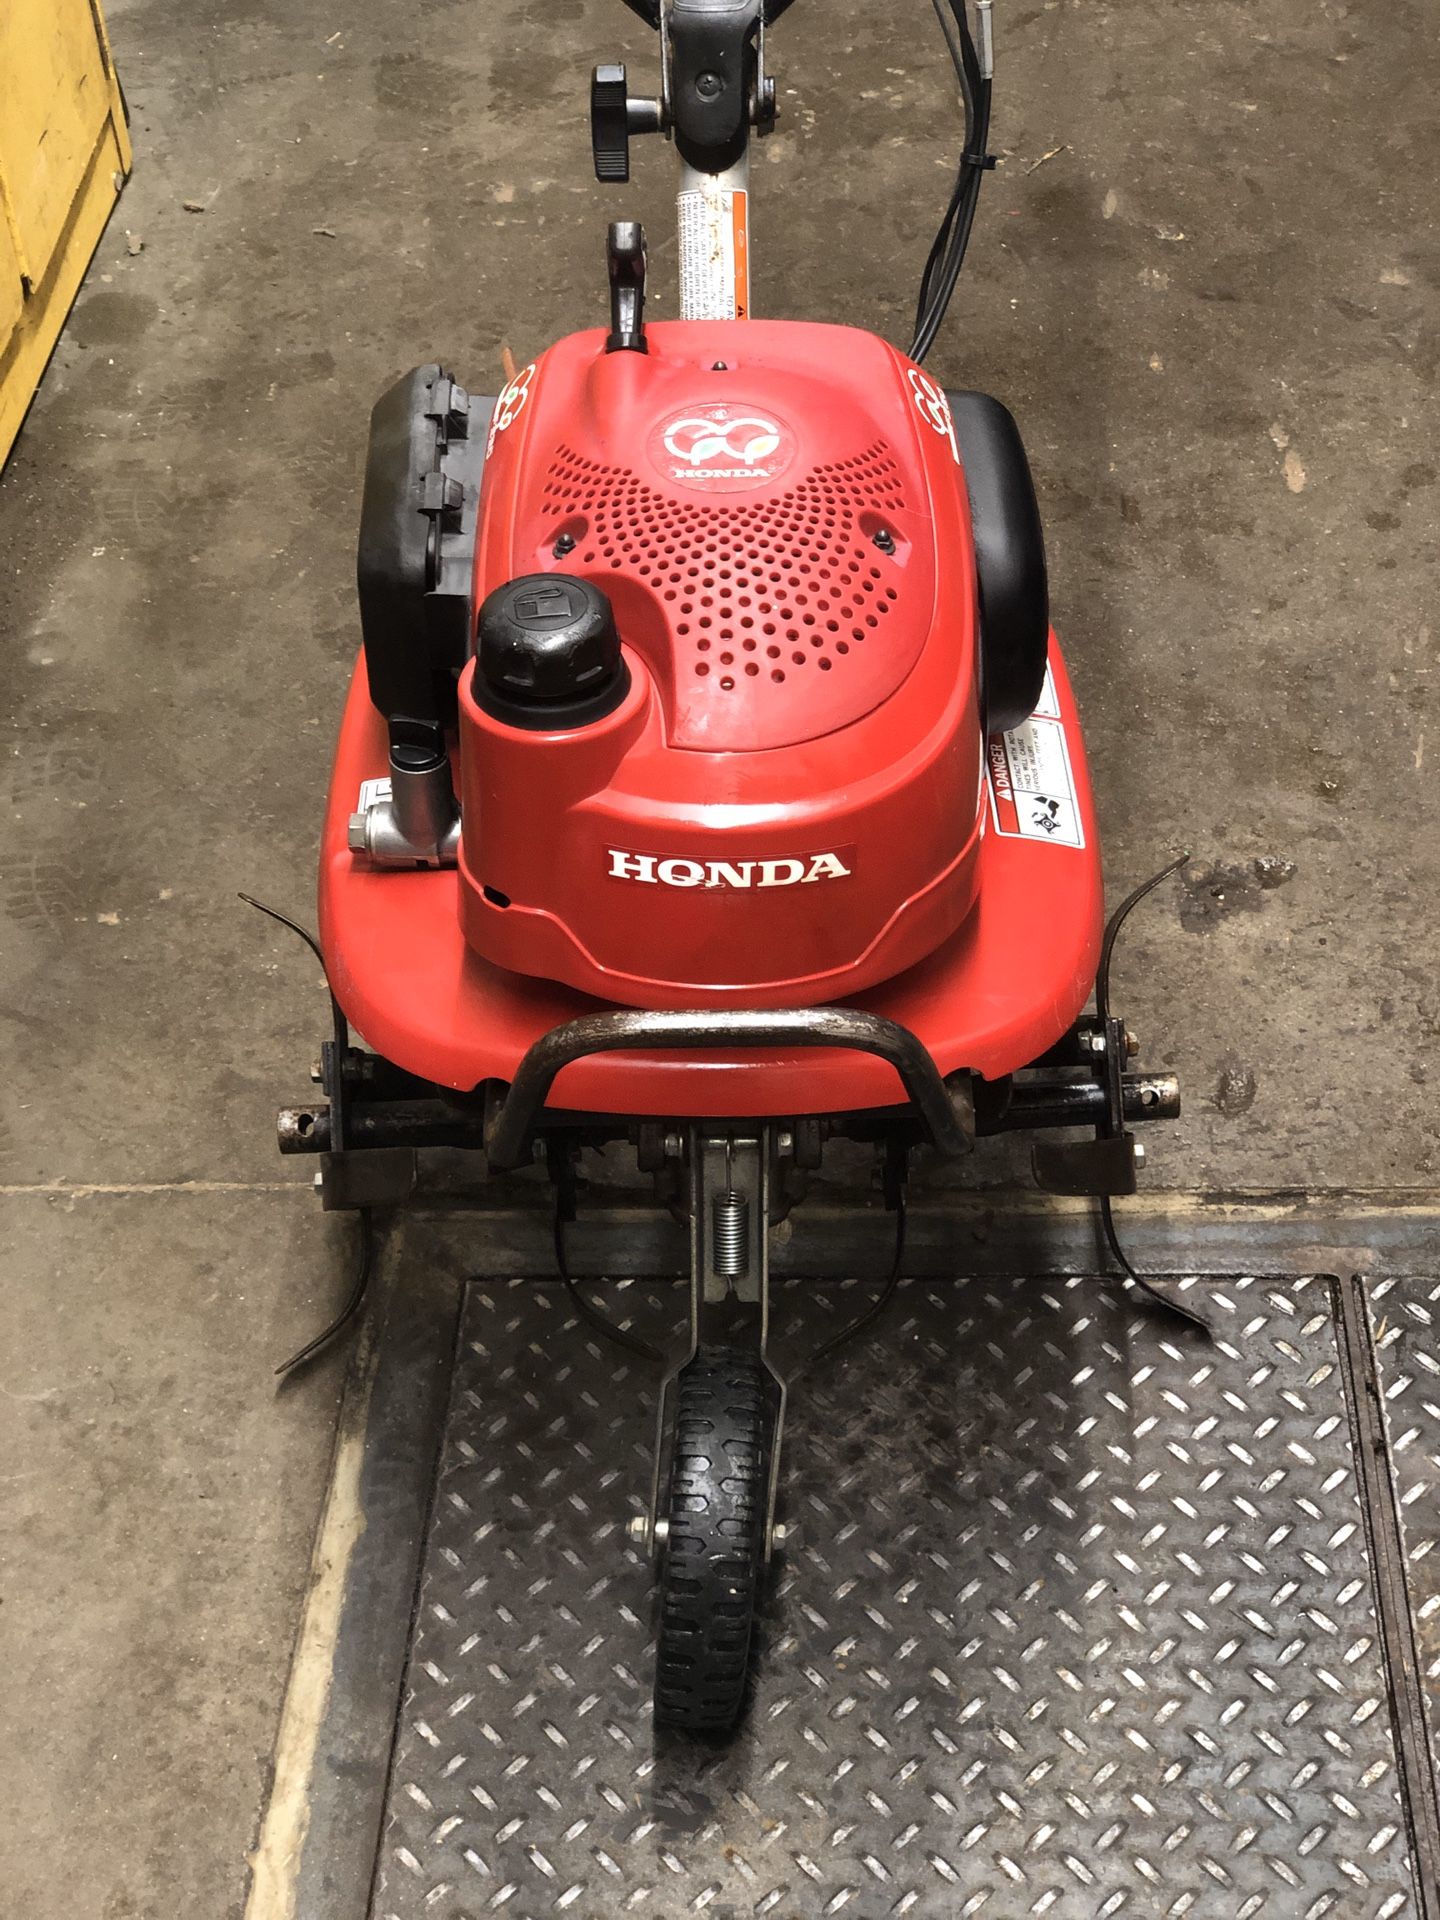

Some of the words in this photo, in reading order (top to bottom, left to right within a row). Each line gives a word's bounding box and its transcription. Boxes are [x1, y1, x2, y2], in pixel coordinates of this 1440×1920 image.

[674, 468, 771, 478] HONDA
[1007, 731, 1016, 745] ROTA
[1010, 747, 1019, 761] WITH
[1017, 737, 1026, 756] CAUSE
[990, 744, 1010, 787] DANGER
[1021, 758, 1029, 771] WILL
[1013, 763, 1024, 789] CONTACT
[608, 849, 851, 888] HONDA
